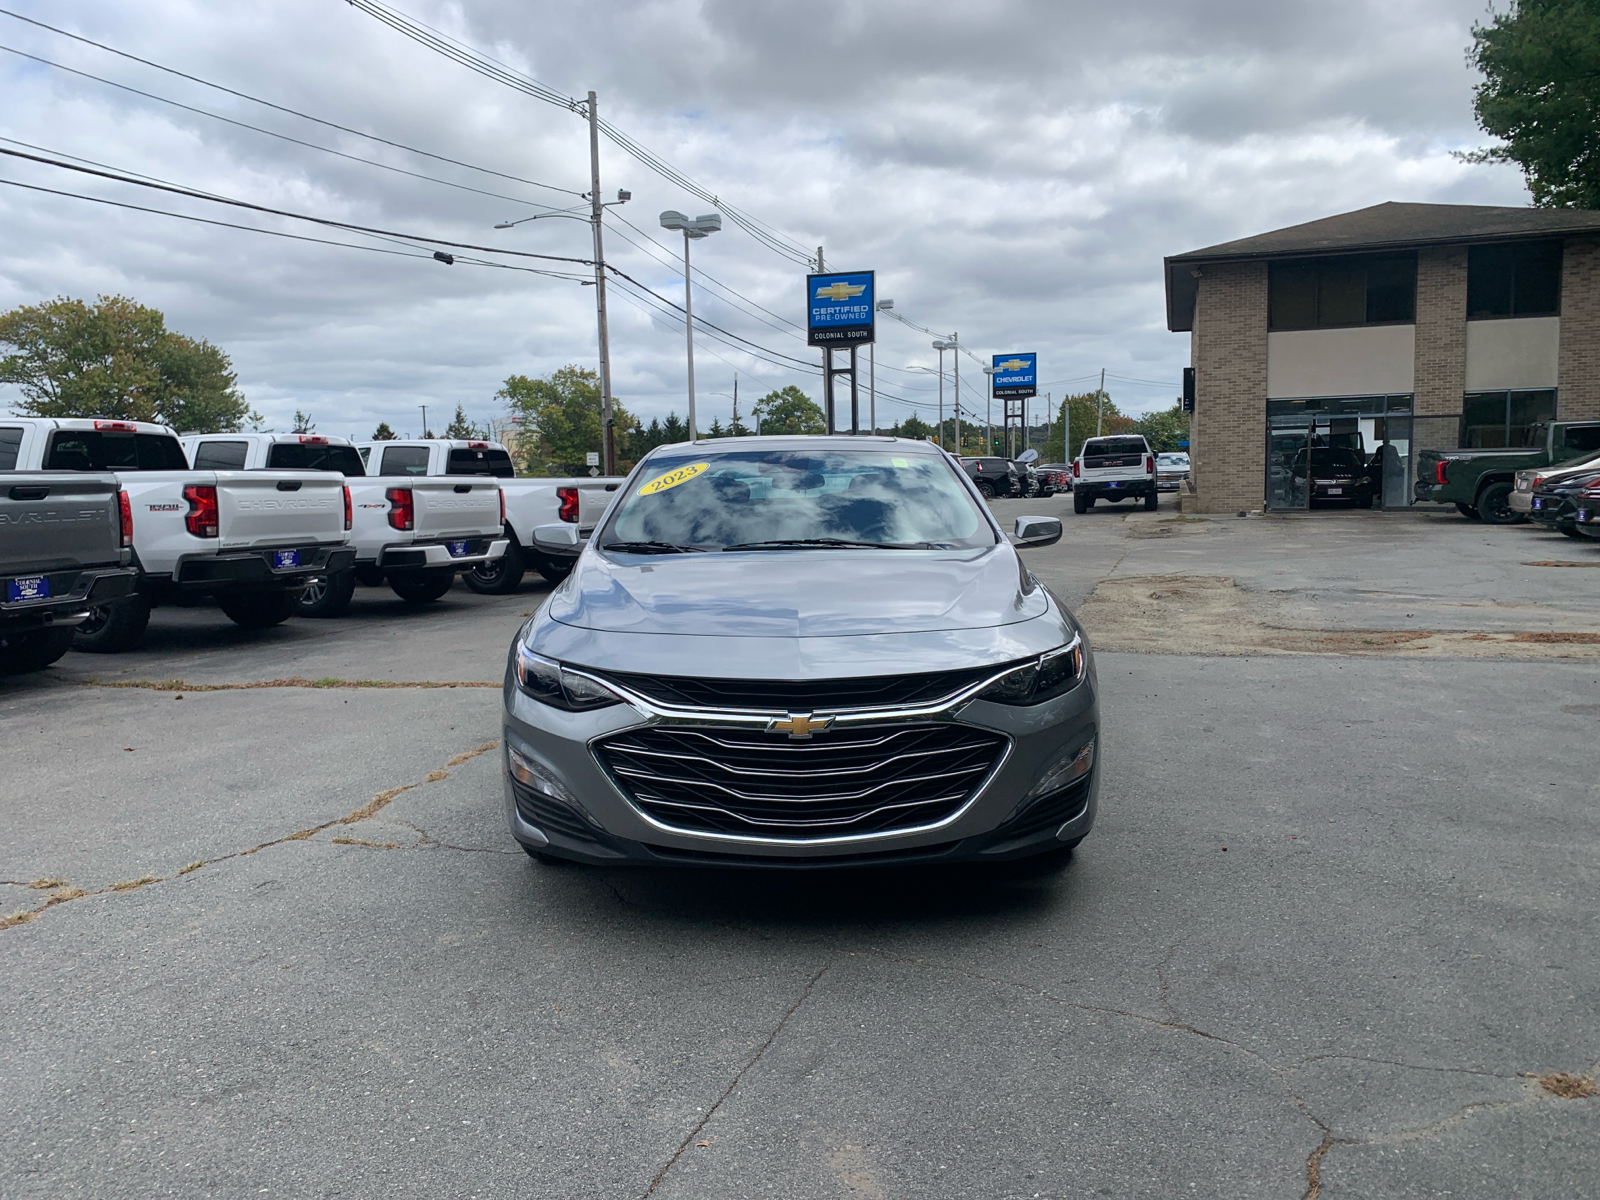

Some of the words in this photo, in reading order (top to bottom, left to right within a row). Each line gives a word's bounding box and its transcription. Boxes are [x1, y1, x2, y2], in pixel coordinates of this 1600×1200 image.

[812, 305, 869, 315] CERTIFIED
[815, 312, 866, 321] PRE-OWNED
[814, 332, 845, 340] COLONIAL
[847, 330, 868, 338] SOUTH
[651, 466, 698, 491] 2023
[238, 498, 337, 511] CHEVROLET
[427, 500, 496, 509] CHEVROLET
